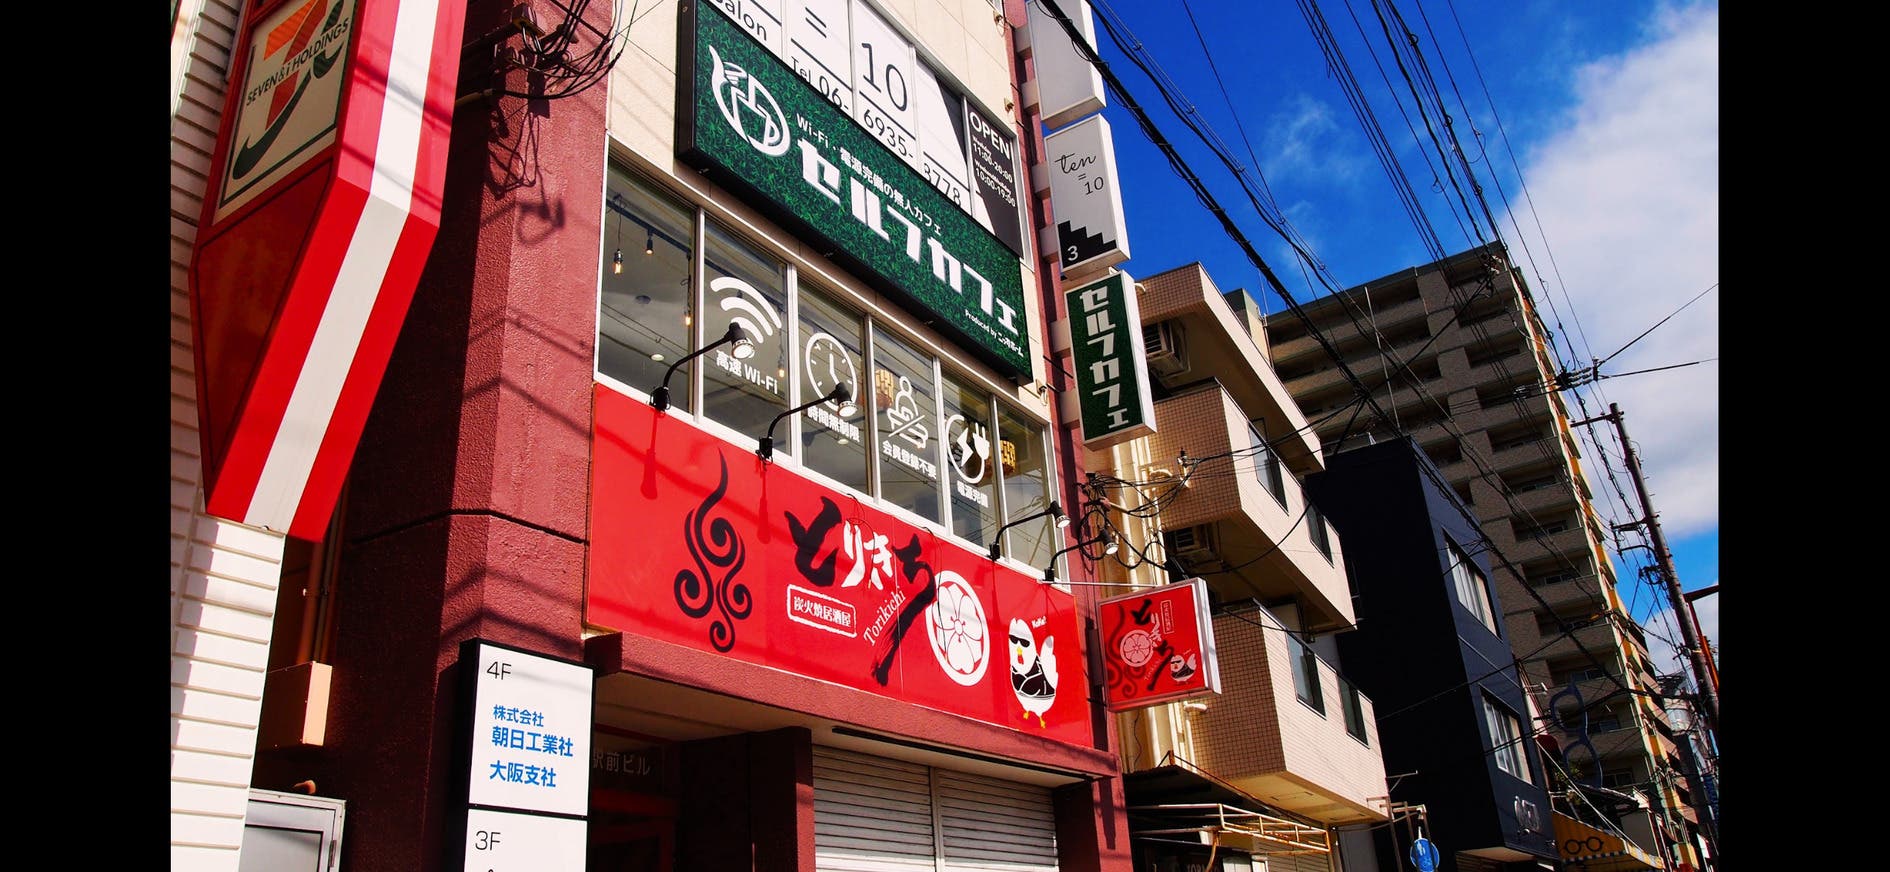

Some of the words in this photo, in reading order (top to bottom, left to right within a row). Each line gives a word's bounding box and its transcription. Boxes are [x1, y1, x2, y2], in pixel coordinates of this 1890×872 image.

[715, 0, 766, 41] alon
[291, 17, 349, 71] HOLDINGS
[862, 42, 908, 112] 10
[969, 111, 1011, 160] OPEN
[1054, 153, 1097, 174] ten
[1084, 176, 1104, 195] 10
[797, 138, 1019, 336] セルフカフェ
[1067, 245, 1079, 261] 3
[716, 349, 742, 377] 高速
[744, 363, 778, 395] Wi-Fi
[1079, 285, 1129, 429] セルフカフェ
[807, 404, 860, 442] 時間無制限
[882, 440, 937, 480] 会員登録不要
[784, 496, 936, 686] とりきち
[793, 596, 852, 628] 炭火焼居酒屋
[863, 586, 907, 647] Torikichi
[486, 661, 512, 680] 4F
[492, 703, 545, 727] 株式会社
[491, 726, 574, 757] 朝日工業社
[489, 759, 557, 788] 大阪支社
[475, 830, 502, 851] 3F
